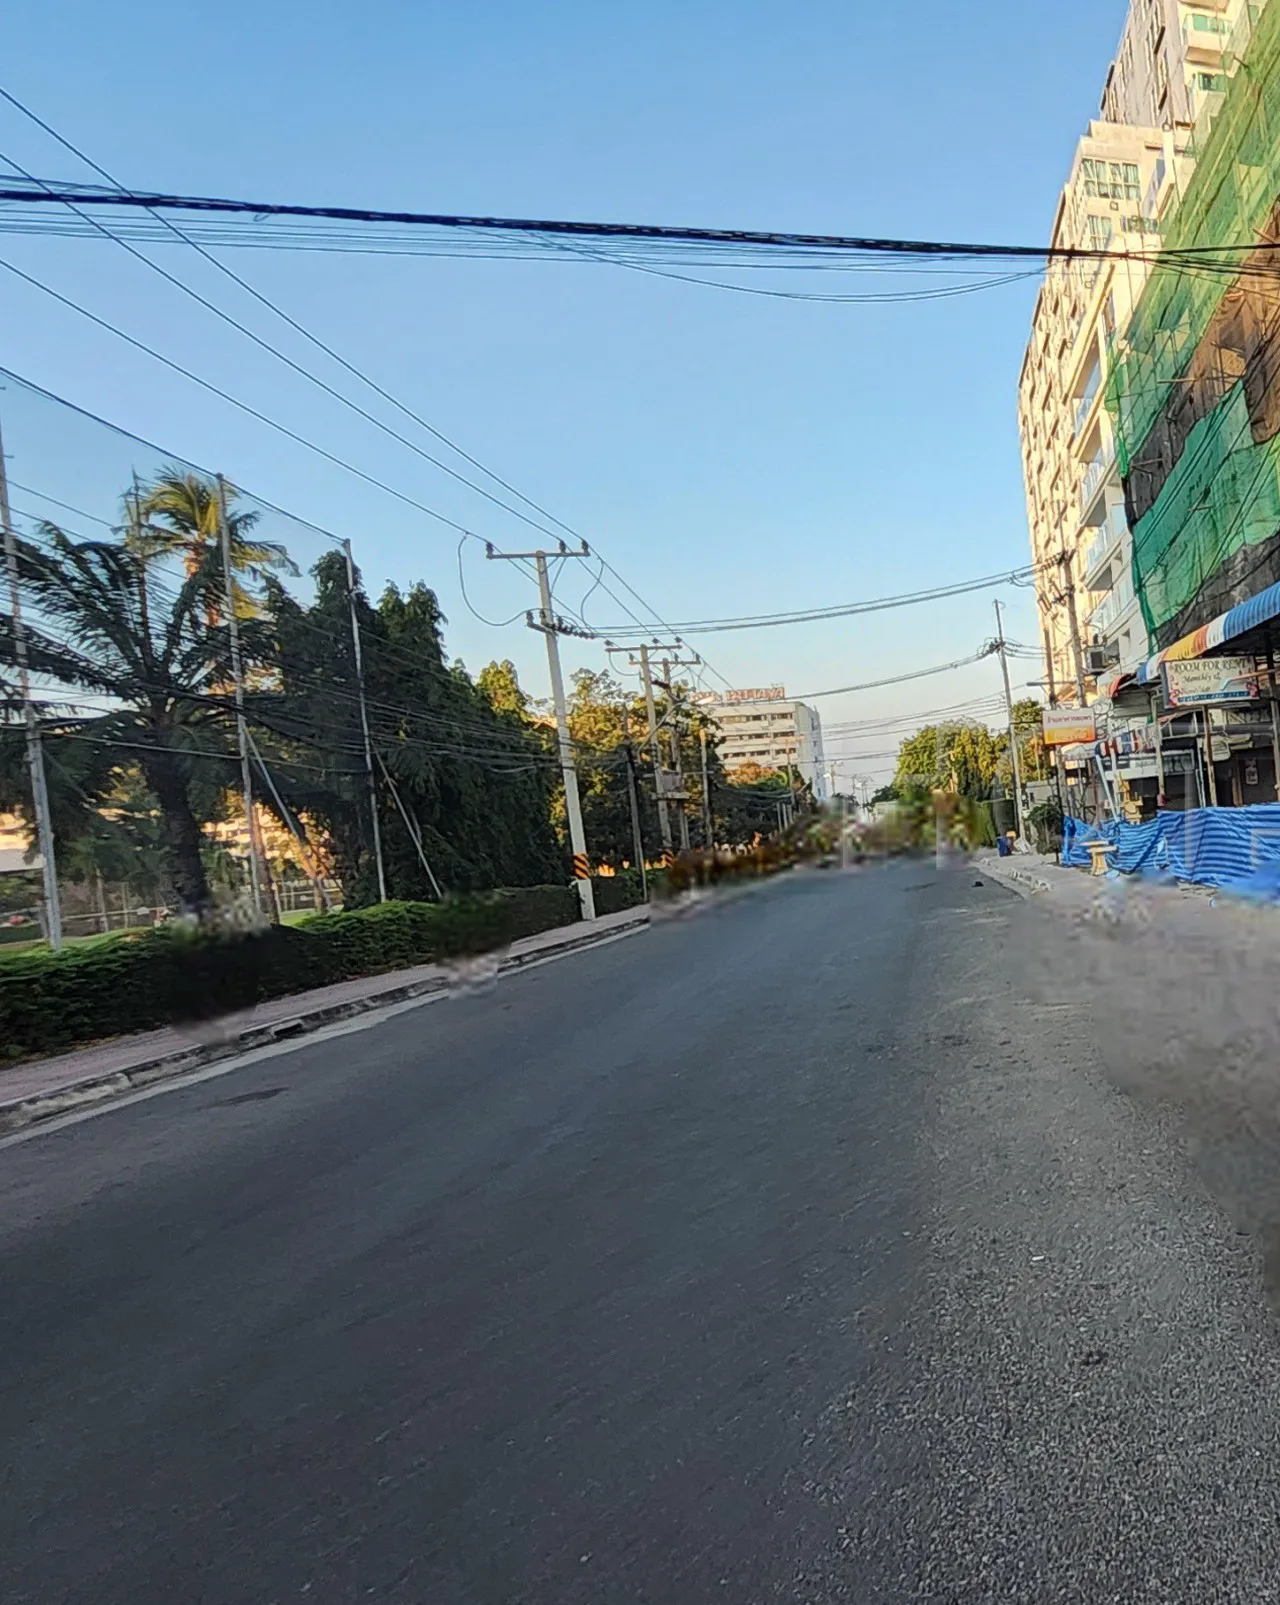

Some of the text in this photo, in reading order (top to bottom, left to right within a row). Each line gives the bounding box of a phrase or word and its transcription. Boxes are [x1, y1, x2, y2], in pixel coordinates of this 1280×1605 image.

[1174, 658, 1247, 673] ROOM FOR RENT
[725, 687, 785, 700] PATTAYA
